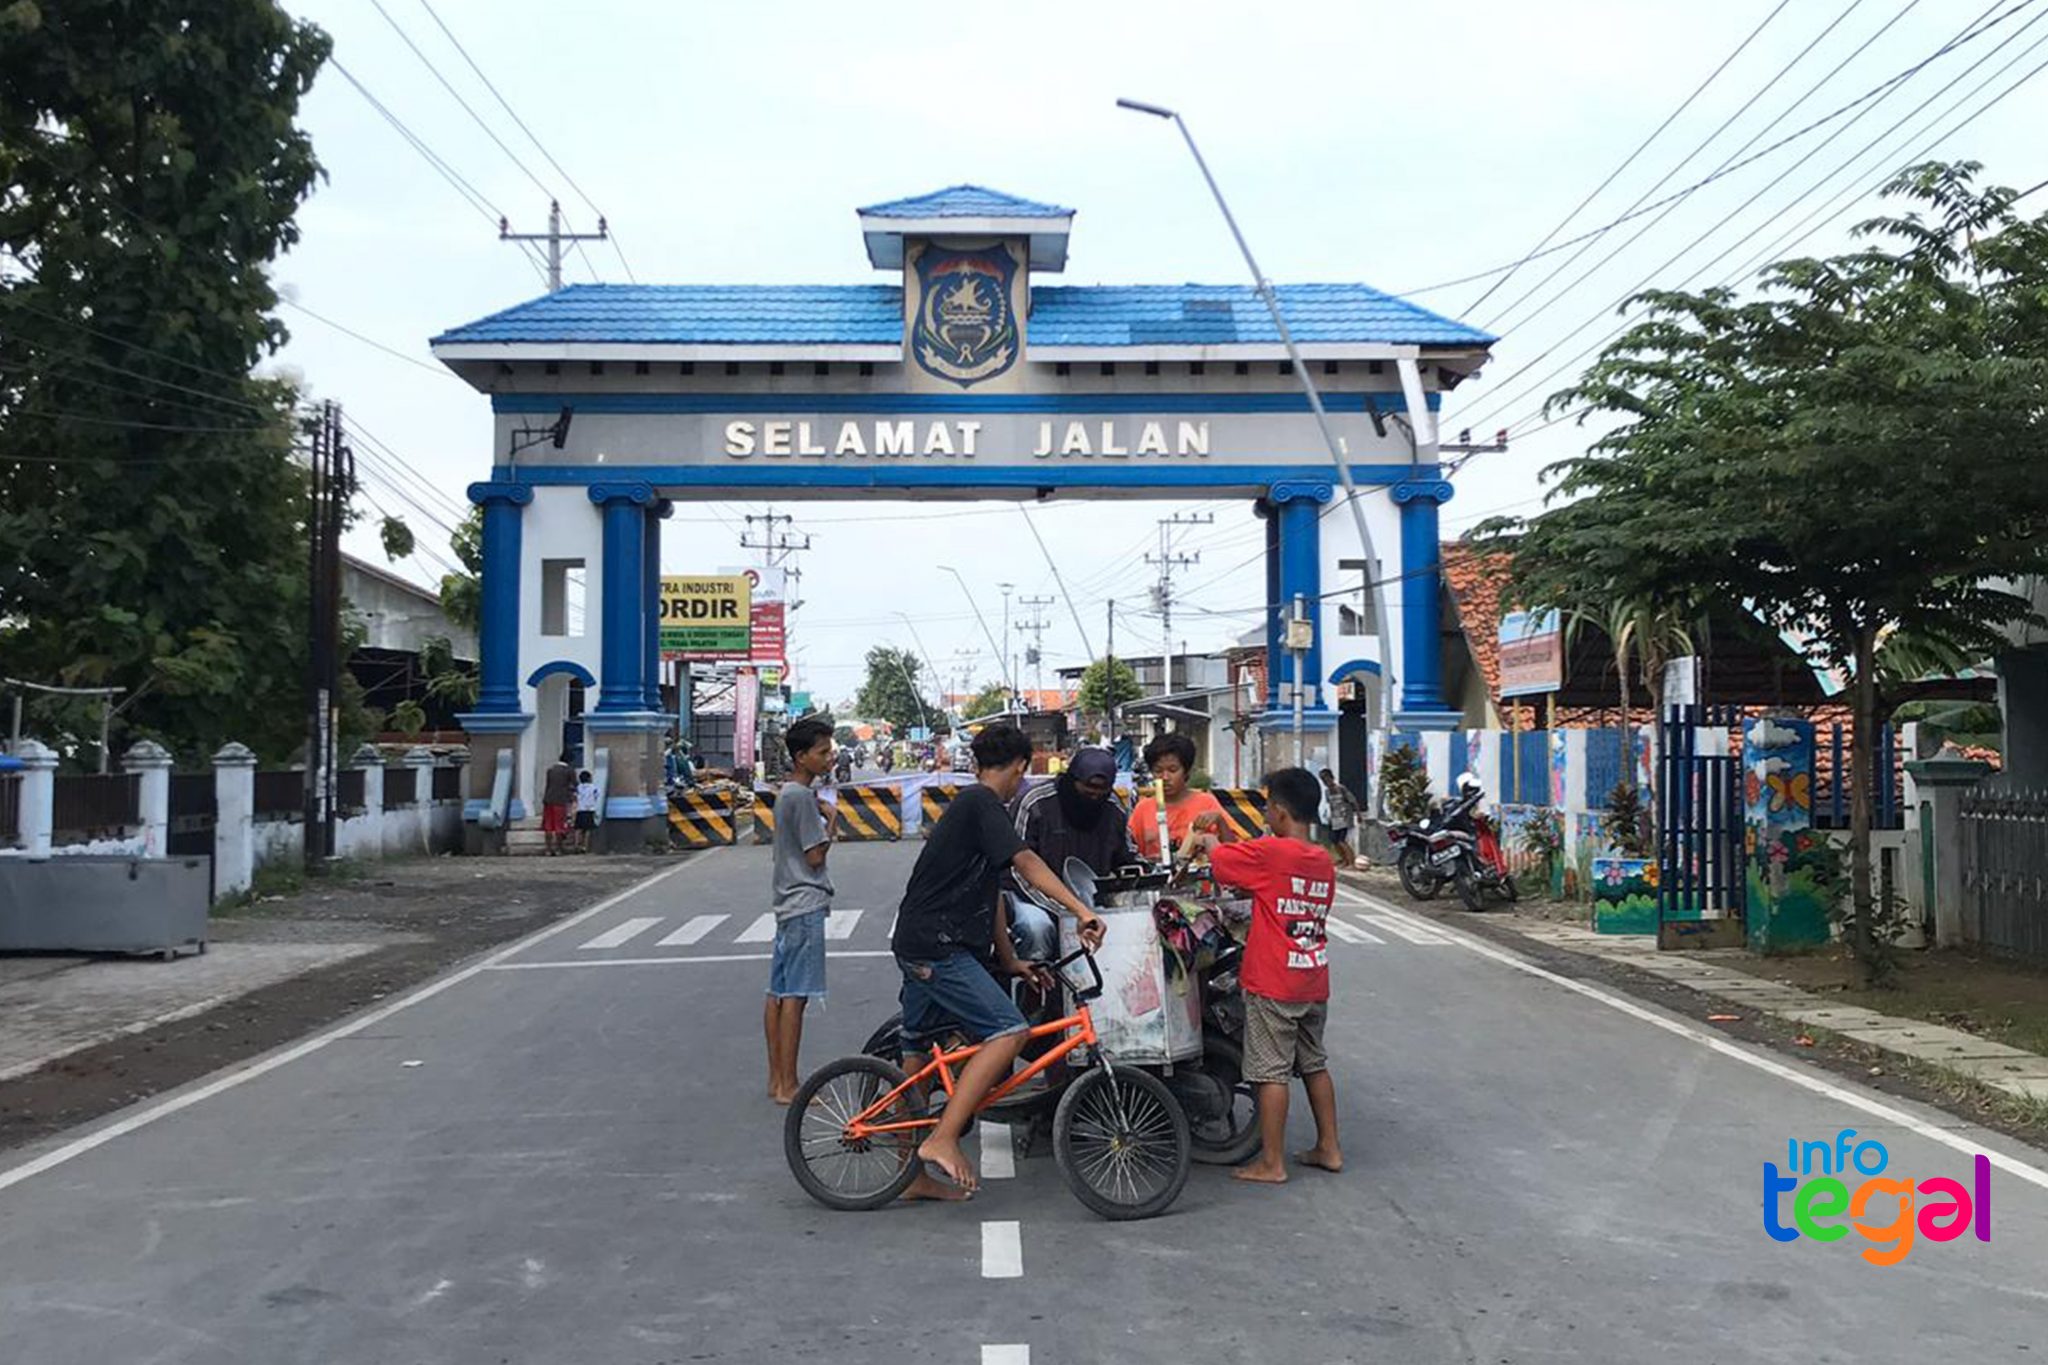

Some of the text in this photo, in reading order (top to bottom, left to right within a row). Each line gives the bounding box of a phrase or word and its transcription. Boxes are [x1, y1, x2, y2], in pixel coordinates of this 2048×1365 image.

[724, 421, 1210, 457] SELAMAT JALAN
[682, 583, 734, 594] INDUSTRI
